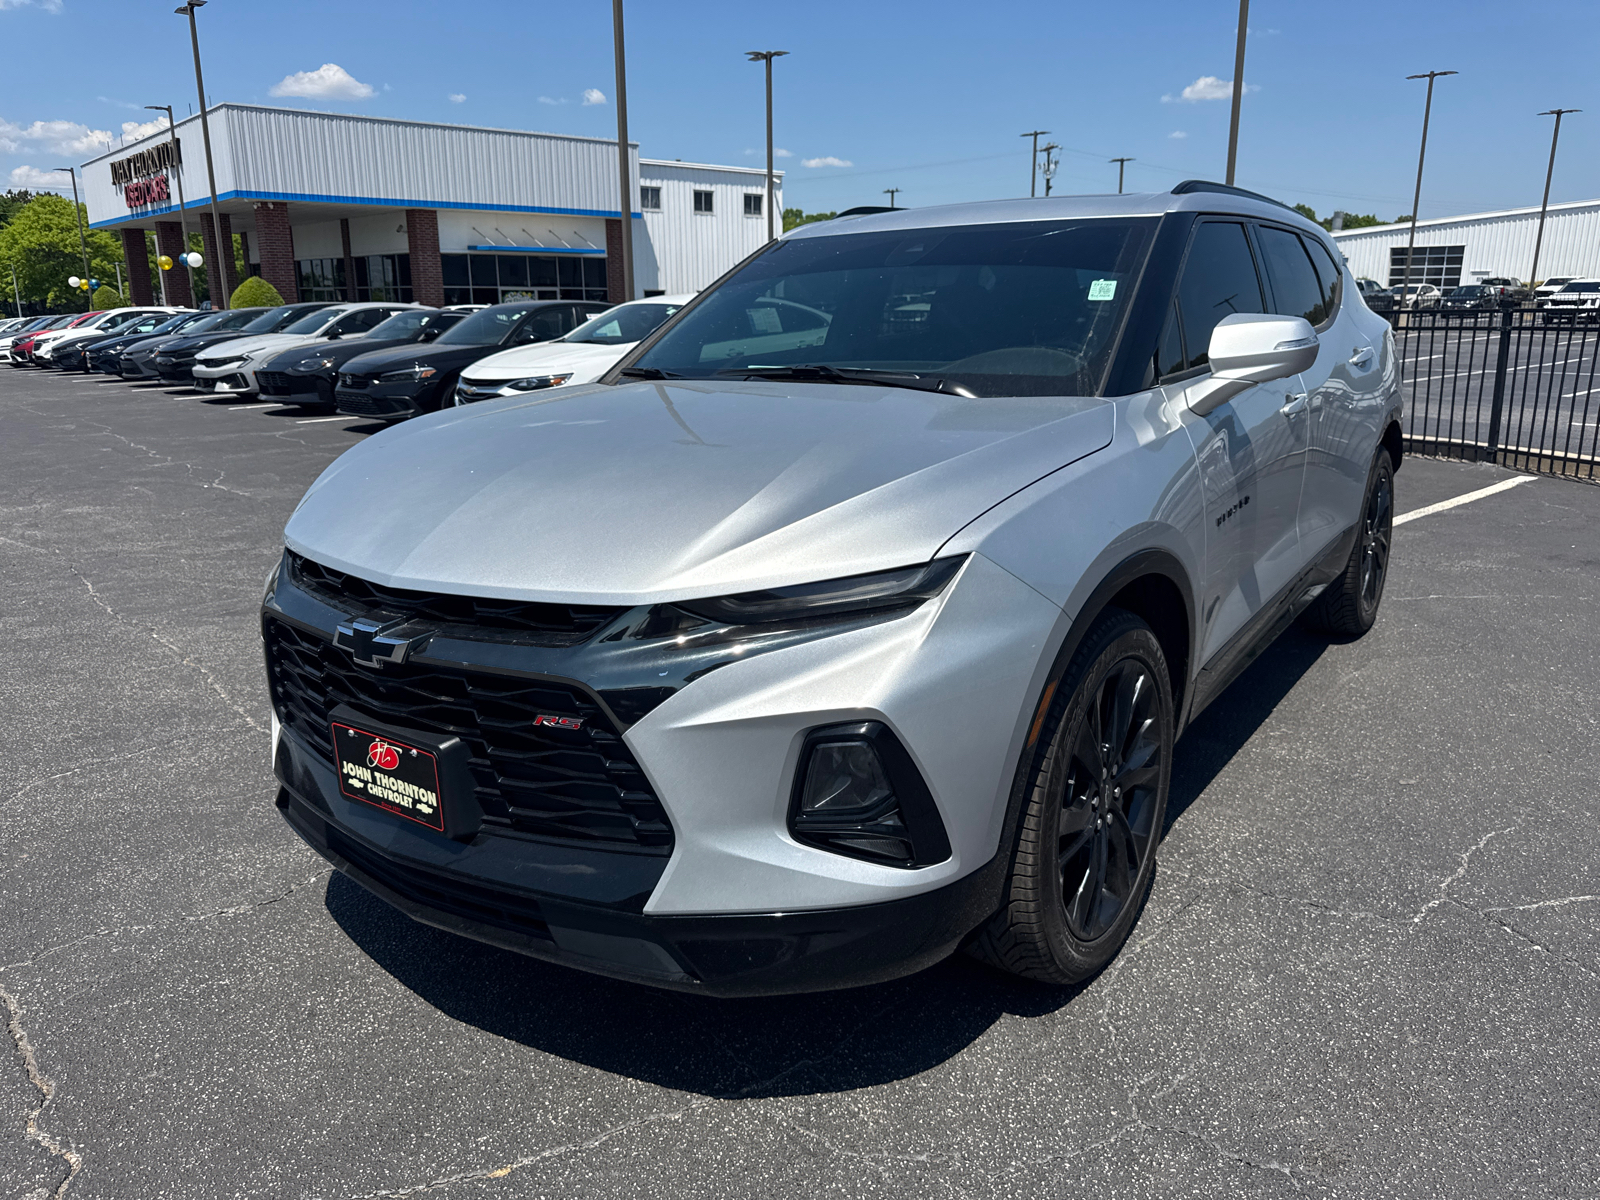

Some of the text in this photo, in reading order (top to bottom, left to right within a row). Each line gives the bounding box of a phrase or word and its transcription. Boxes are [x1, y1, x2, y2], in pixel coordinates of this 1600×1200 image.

[124, 174, 168, 208] USED CARS
[532, 715, 584, 730] RS
[342, 760, 438, 807] JOHN THORNTON
[367, 783, 413, 809] CHEVROLET
